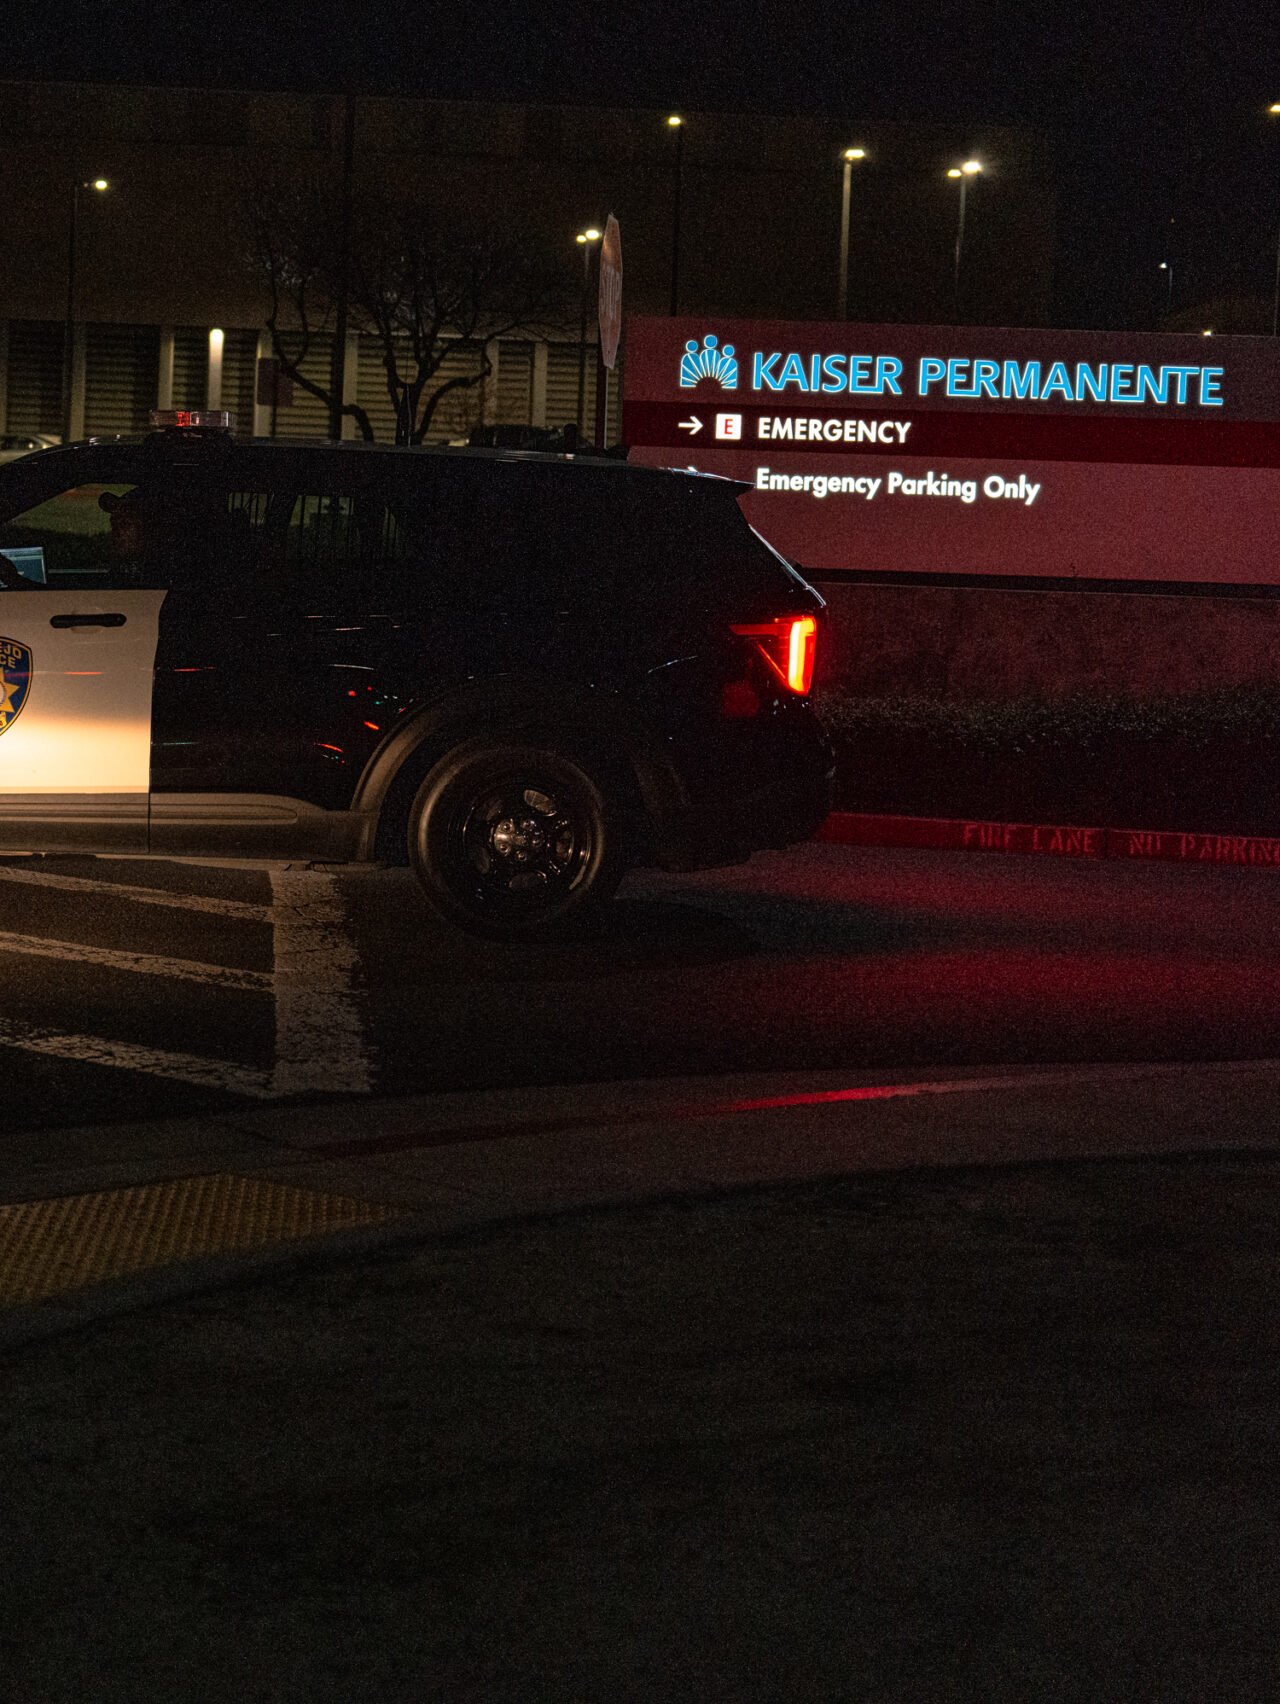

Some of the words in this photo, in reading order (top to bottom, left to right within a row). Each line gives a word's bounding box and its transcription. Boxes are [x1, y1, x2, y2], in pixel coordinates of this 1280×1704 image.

[752, 351, 903, 396] KAISER
[919, 357, 1225, 406] PERMANENTE
[723, 418, 735, 436] E
[757, 417, 913, 444] EMERGENCY
[755, 468, 882, 500] Emergency
[887, 471, 977, 503] Parking
[984, 475, 1042, 505] Only
[1032, 827, 1095, 853] LANE
